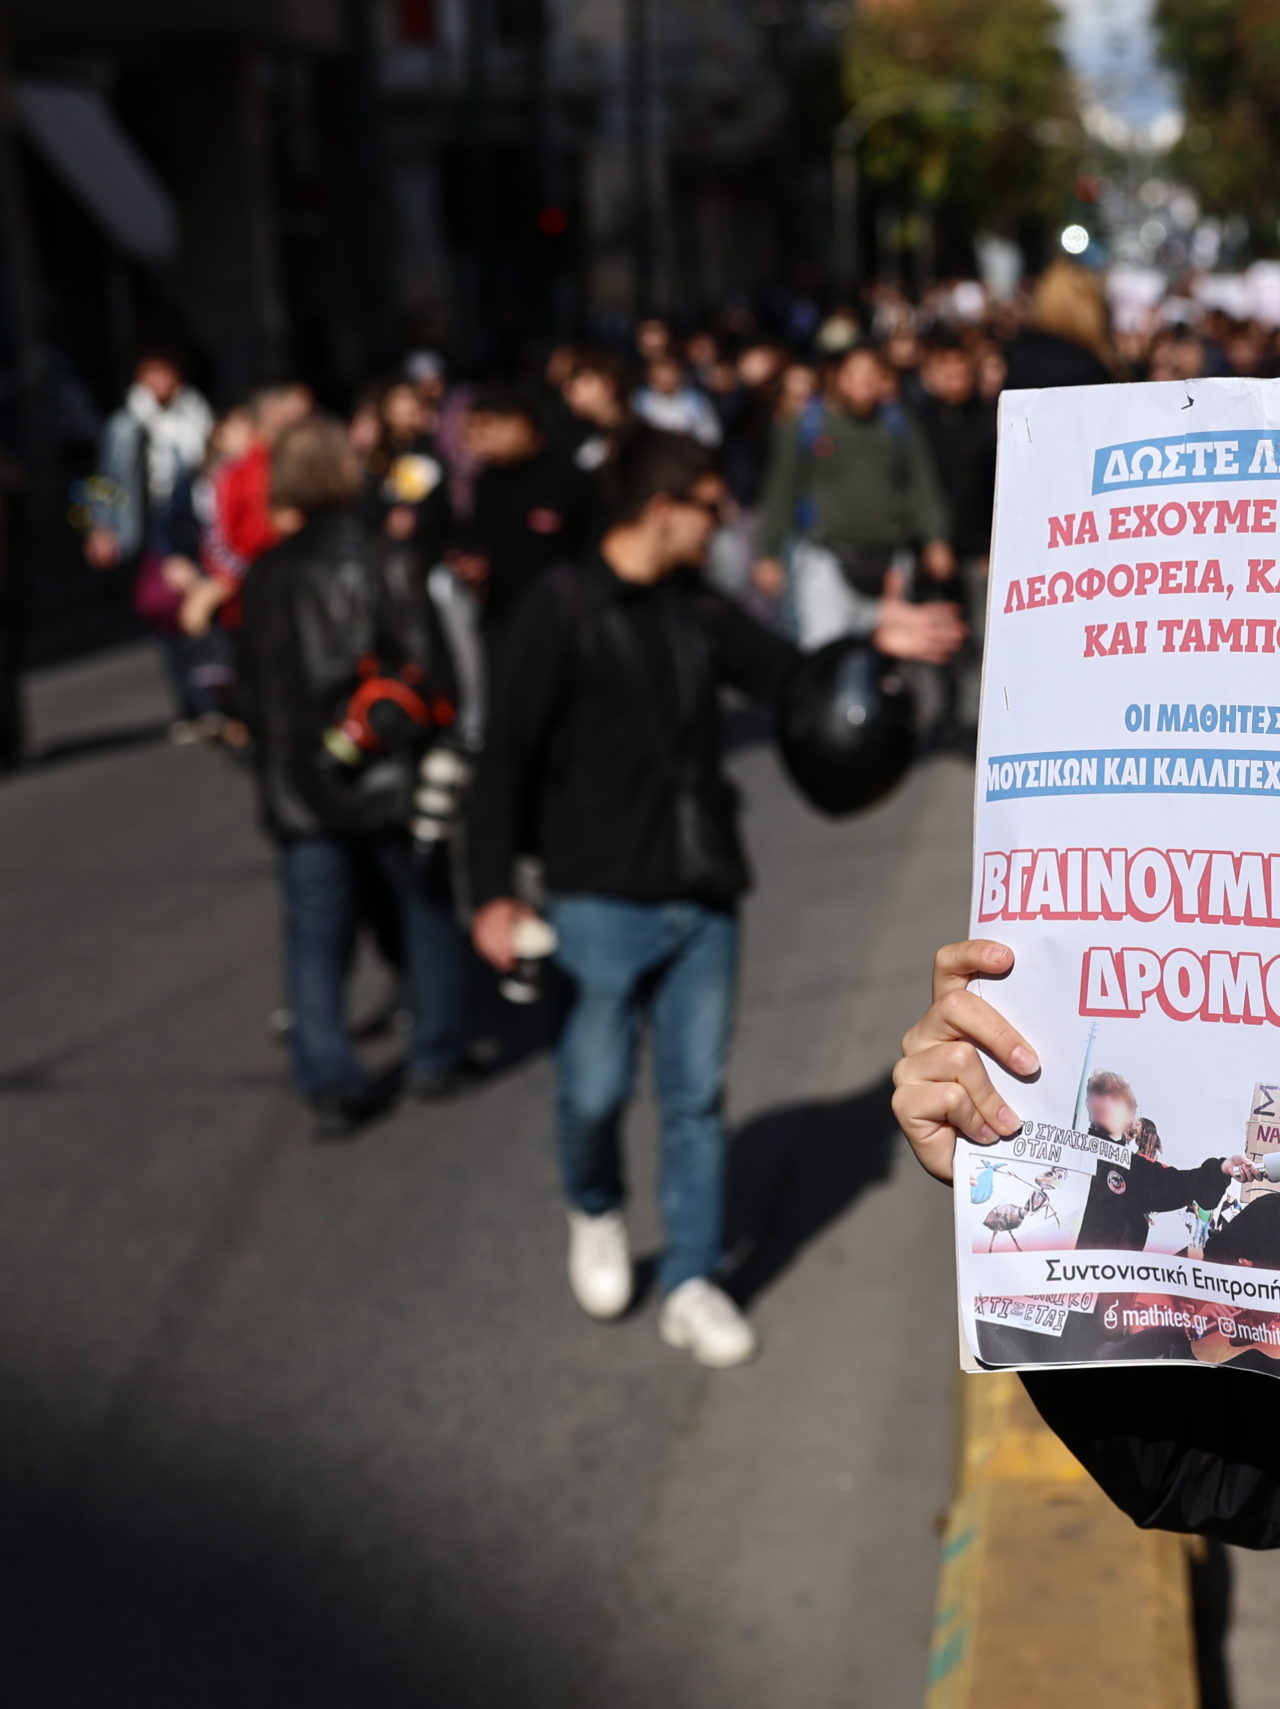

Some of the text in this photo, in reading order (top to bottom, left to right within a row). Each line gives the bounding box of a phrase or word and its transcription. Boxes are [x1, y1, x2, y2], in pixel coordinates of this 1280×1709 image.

[1103, 440, 1240, 484] ΔΩΣΤΕ
[1048, 510, 1100, 550] ΝΑ
[1108, 499, 1277, 540] ΕΧΟΥΜΕ
[1003, 559, 1235, 614] ΛΕΩΦΟΡΕΙΑ,
[1083, 620, 1149, 658] ΚΑΙ
[1124, 703, 1152, 733] ΟΙ
[986, 758, 1098, 792] ΜΟΥΣΙΚΩΝ
[1103, 757, 1146, 785] ΚΑΙ
[1013, 1138, 1063, 1163] ΟΤΑΝ
[1035, 1123, 1131, 1166] ΣΥΝΑΙΣΘΗΜΑ
[1045, 1259, 1188, 1287] Συντονιστική
[1122, 1303, 1209, 1334] mathites.gr
